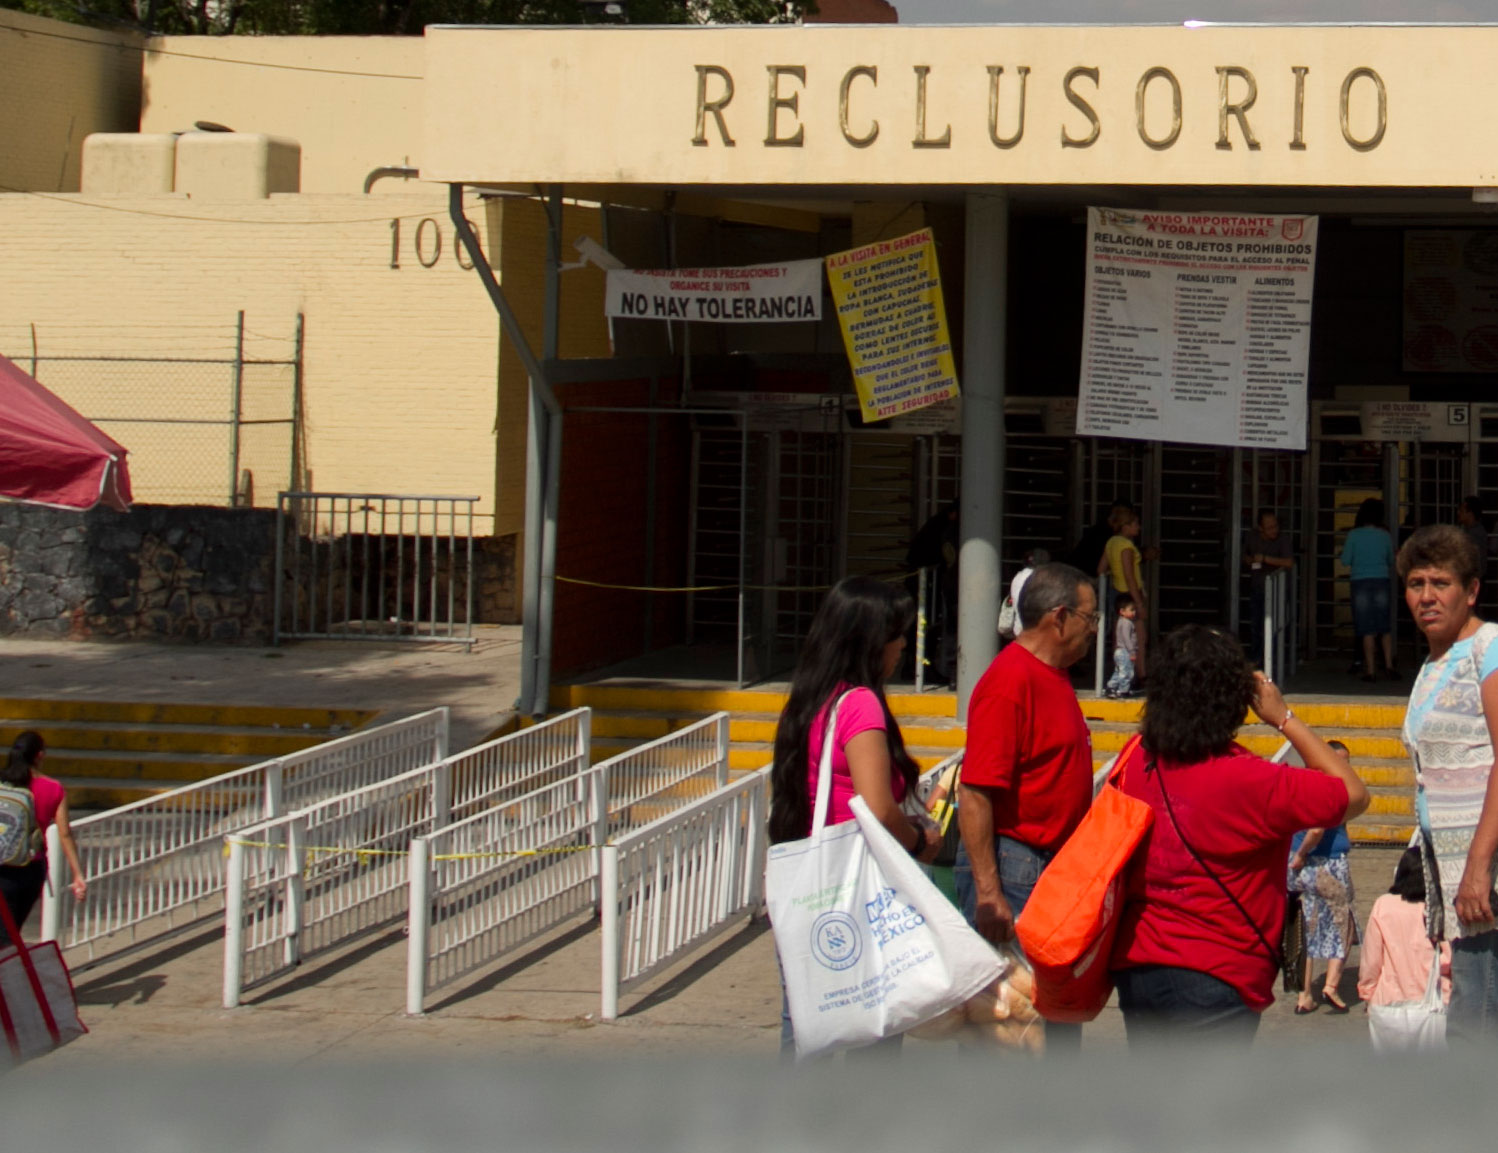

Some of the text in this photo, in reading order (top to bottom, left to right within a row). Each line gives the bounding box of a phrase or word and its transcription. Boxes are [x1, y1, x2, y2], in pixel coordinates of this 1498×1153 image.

[691, 64, 1387, 152] RECLUSORIO
[1143, 214, 1181, 224] AVISO
[1187, 215, 1275, 227] IMPORTANTE
[1161, 225, 1195, 235] TODA
[1200, 227, 1216, 236] LA
[1094, 232, 1312, 255] RELACIÓN DE OBJETOS PROHIBIDOS
[830, 258, 836, 268] A
[838, 256, 848, 266] LA
[702, 268, 718, 278] SUS
[780, 267, 788, 277] Y
[670, 280, 752, 292] ORGANICE SU VISITA
[621, 292, 816, 319] NO HAY TOLERANCIA
[1452, 408, 1465, 422] 5
